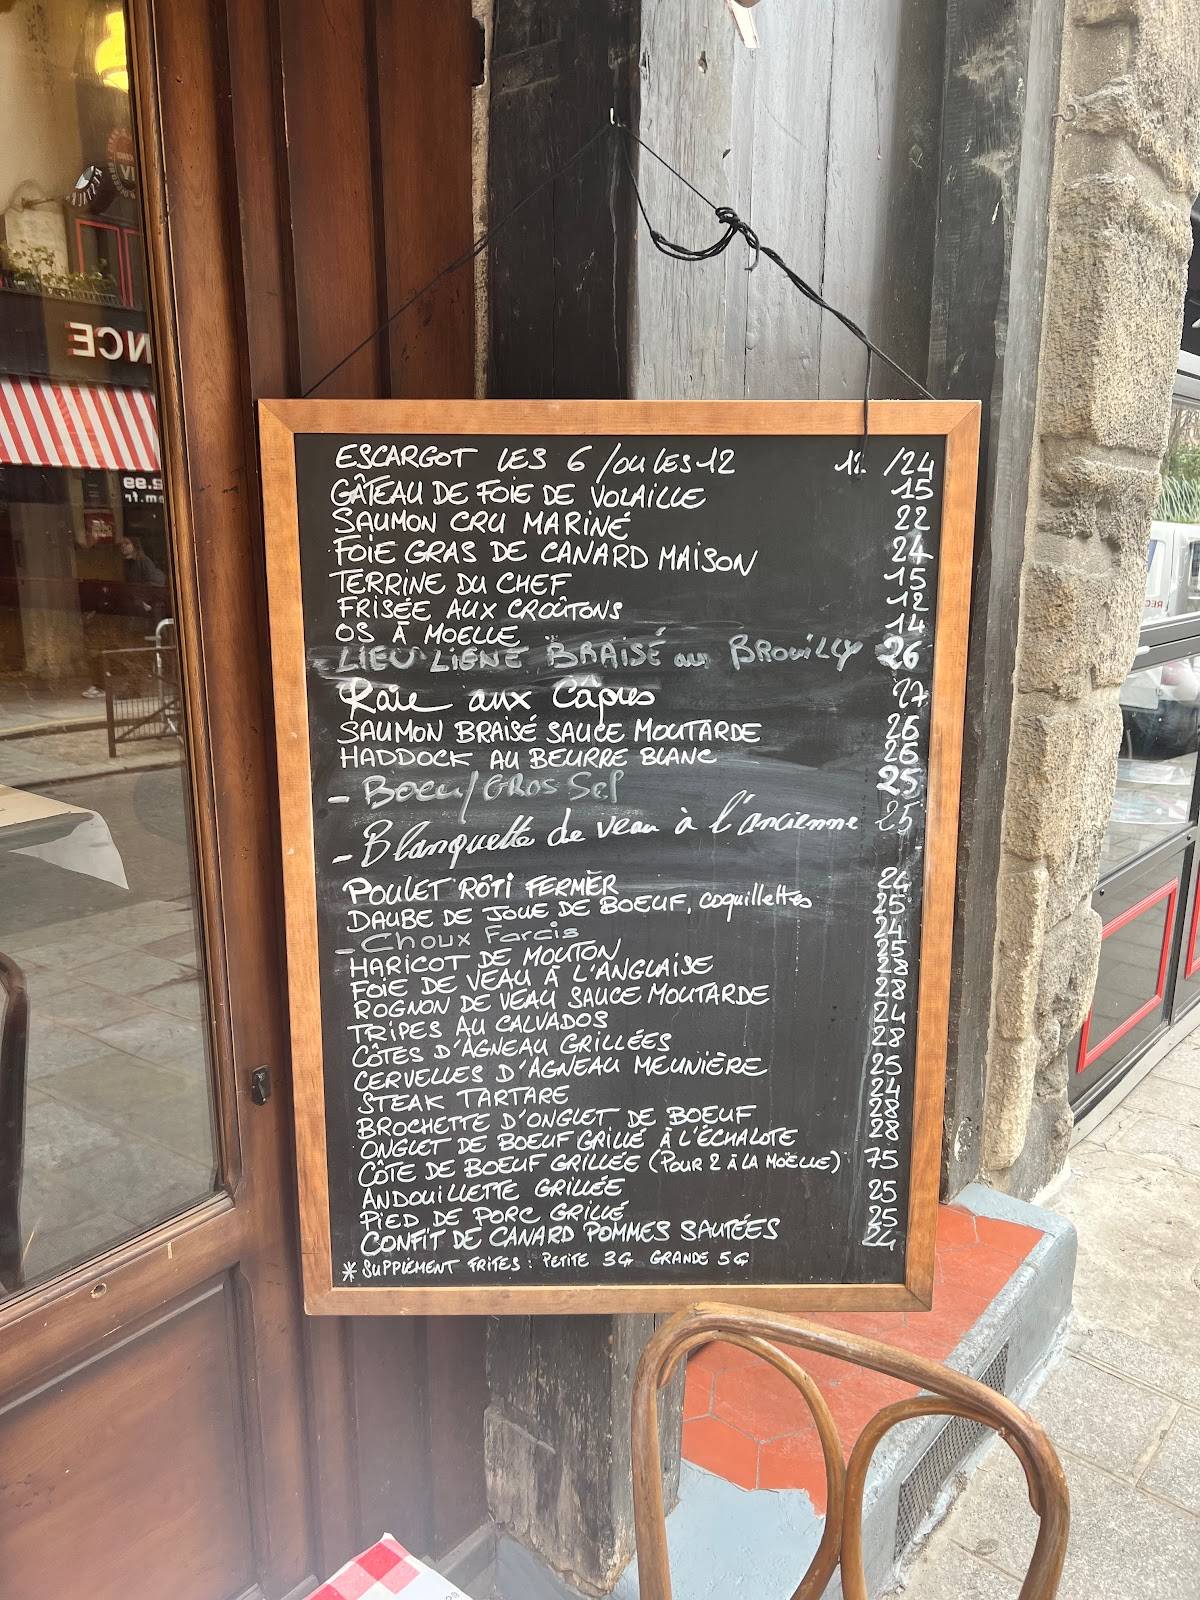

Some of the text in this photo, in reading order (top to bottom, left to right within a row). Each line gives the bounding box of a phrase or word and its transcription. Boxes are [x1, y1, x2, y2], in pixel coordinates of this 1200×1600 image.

[335, 443, 478, 470] ESCARGOT
[497, 447, 547, 472] LES
[566, 445, 593, 472] 6
[654, 448, 692, 474] LES
[696, 447, 736, 475] 12
[883, 447, 934, 480] /24
[330, 473, 706, 509] GÂTEAU DE FOIE DE VOLAILLE
[891, 476, 933, 500] 15
[332, 507, 631, 540] SAUMON CRU MARINÉ
[895, 505, 930, 530] 22
[333, 534, 758, 577] FOIE GRAS DE CANARD MAISON
[892, 535, 934, 565] 24
[329, 568, 572, 596] TERRINE DU CHEF
[883, 567, 927, 590] 15
[337, 595, 431, 620] FRISÉE
[446, 598, 498, 620] AUX
[886, 592, 929, 612] 12
[335, 622, 375, 643] OS
[425, 625, 521, 647] MOELLE
[885, 613, 925, 634] 14
[546, 627, 666, 669] BRAISÉ
[877, 636, 923, 669] 26
[469, 689, 532, 712] aux
[893, 678, 929, 708] 27
[337, 714, 762, 743] SAUMON BRAISÉ SAUCE MOUTARDE
[886, 713, 920, 740] 26
[340, 746, 718, 770] HADDOCK AU BEURRE BLANC
[884, 741, 920, 765] 26
[876, 765, 921, 797] 25
[361, 790, 858, 869] Blanquette de veau à l'ancienne
[875, 800, 919, 833] 25
[342, 876, 452, 905] POULET
[459, 873, 514, 899] RÔTI
[877, 866, 911, 890] 24
[347, 909, 433, 932] DAUBE
[443, 908, 472, 927] DE
[482, 903, 548, 922] JOUE
[558, 899, 590, 918] DE
[872, 892, 905, 915] 25
[874, 916, 902, 939] 24
[361, 931, 471, 953] Choux
[876, 939, 907, 957] 25
[350, 938, 621, 978] HARICOT DE MOUTON
[877, 956, 909, 976] 28
[350, 978, 408, 1001] FOIE
[421, 975, 458, 995] DE
[467, 969, 531, 992] VEAU
[573, 952, 713, 983] L'ANGLAISE
[874, 976, 906, 1000] 28
[354, 982, 770, 1019] ROGNON DE VEAU SAUCE MOUTARDE
[874, 1002, 905, 1024] 24
[347, 1010, 609, 1044] TRIPES AU CALVADOS
[872, 1025, 905, 1047] 28
[352, 1029, 672, 1068] CÔTES D'AGNEAU GRILLÉES
[354, 1065, 484, 1092] CERVELLES
[495, 1057, 620, 1083] D'AGNEAU
[870, 1053, 903, 1076] 25
[356, 1085, 570, 1114] STEAK TARTARE
[870, 1078, 900, 1100] 24
[356, 1104, 756, 1140] BROCHETTE D'ONGLET DE BOEUF
[869, 1099, 900, 1119] 28
[360, 1138, 452, 1160] ONGLET
[457, 1135, 487, 1154] DE
[497, 1130, 574, 1152] BOEUF
[679, 1123, 799, 1148] L'ÉCHALOTE
[869, 1119, 899, 1141] 28
[358, 1160, 416, 1187] CÔTE
[425, 1159, 455, 1180] DE
[464, 1153, 547, 1178] BOEUF
[550, 1151, 640, 1172] GRILLÉE
[649, 1150, 702, 1173] (POUR
[709, 1155, 721, 1171] 2
[741, 1153, 759, 1170] LA
[864, 1147, 899, 1170] 75
[362, 1175, 626, 1210] ANDOUILLETTE GRILLÉE
[868, 1179, 896, 1203] 25
[360, 1210, 420, 1231] PIED
[432, 1208, 463, 1227] DE
[473, 1206, 541, 1226] PORC
[868, 1205, 898, 1228] 25
[360, 1228, 446, 1256] CONFIT
[452, 1227, 482, 1250] DE
[489, 1225, 575, 1248] CANARD
[583, 1221, 670, 1243] POMMES
[862, 1226, 896, 1251] 24
[467, 1253, 521, 1273] FRITES
[542, 1251, 590, 1268] PETITE
[650, 1251, 709, 1266] GRANDE
